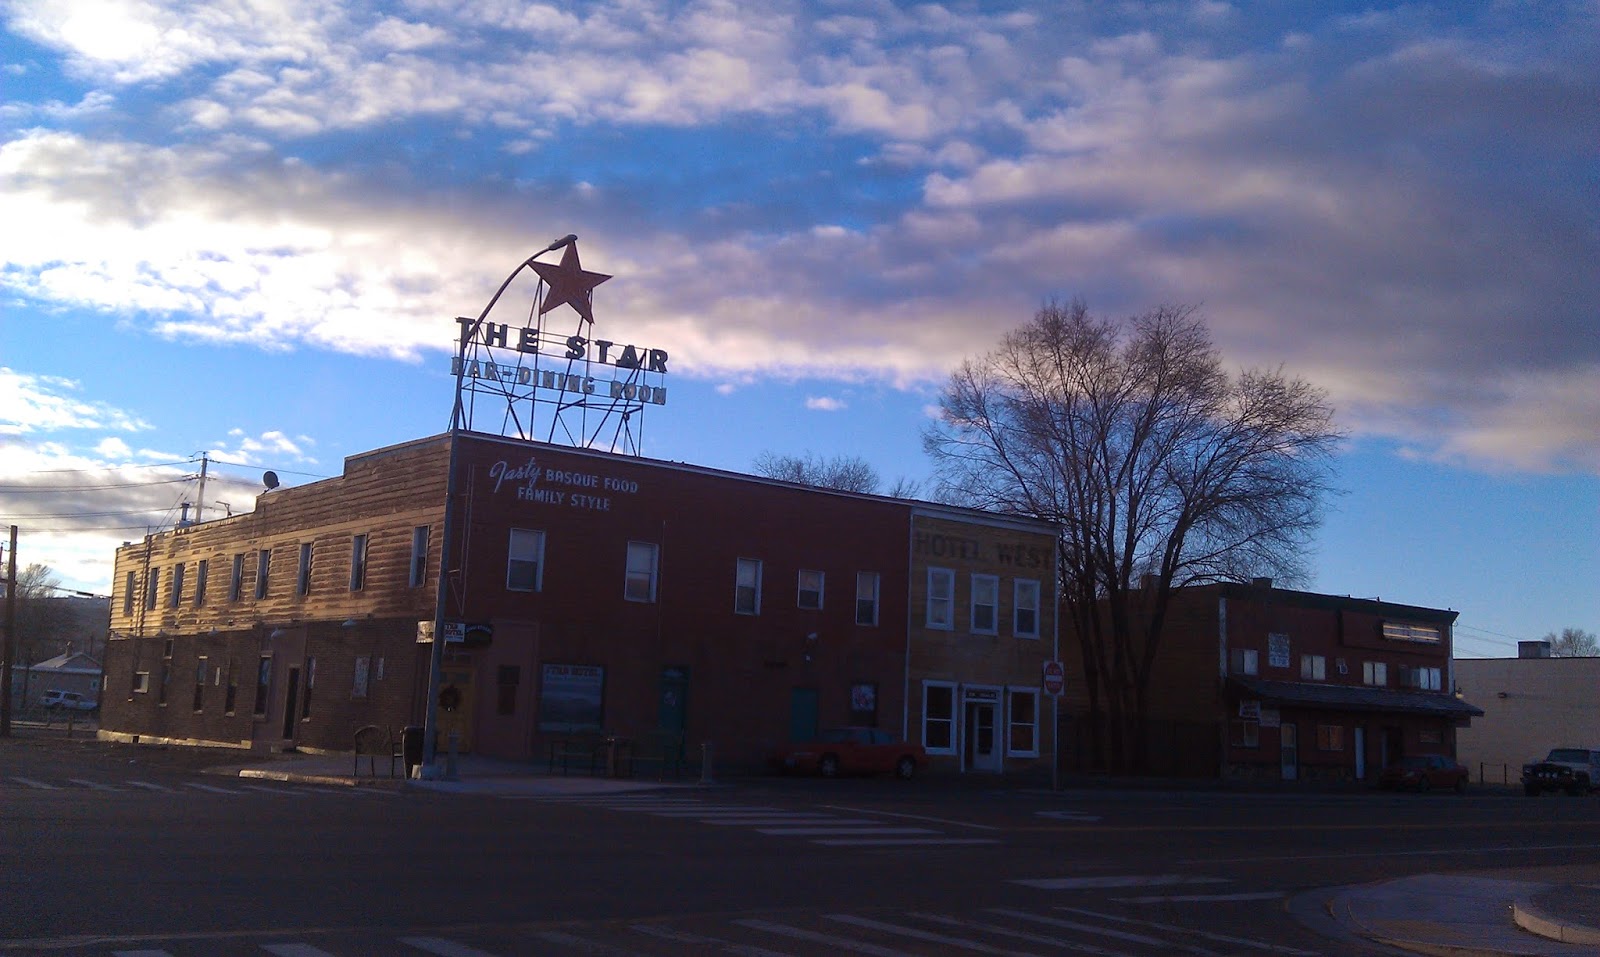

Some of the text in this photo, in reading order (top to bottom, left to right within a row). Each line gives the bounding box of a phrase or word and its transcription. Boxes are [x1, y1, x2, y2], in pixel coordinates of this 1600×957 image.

[455, 316, 669, 373] THE STAR
[610, 380, 667, 405] ROOM
[489, 456, 638, 494] Tasty BASQUE FOOD
[517, 486, 611, 511] FAMILY STYLE
[996, 542, 1054, 570] WEST
